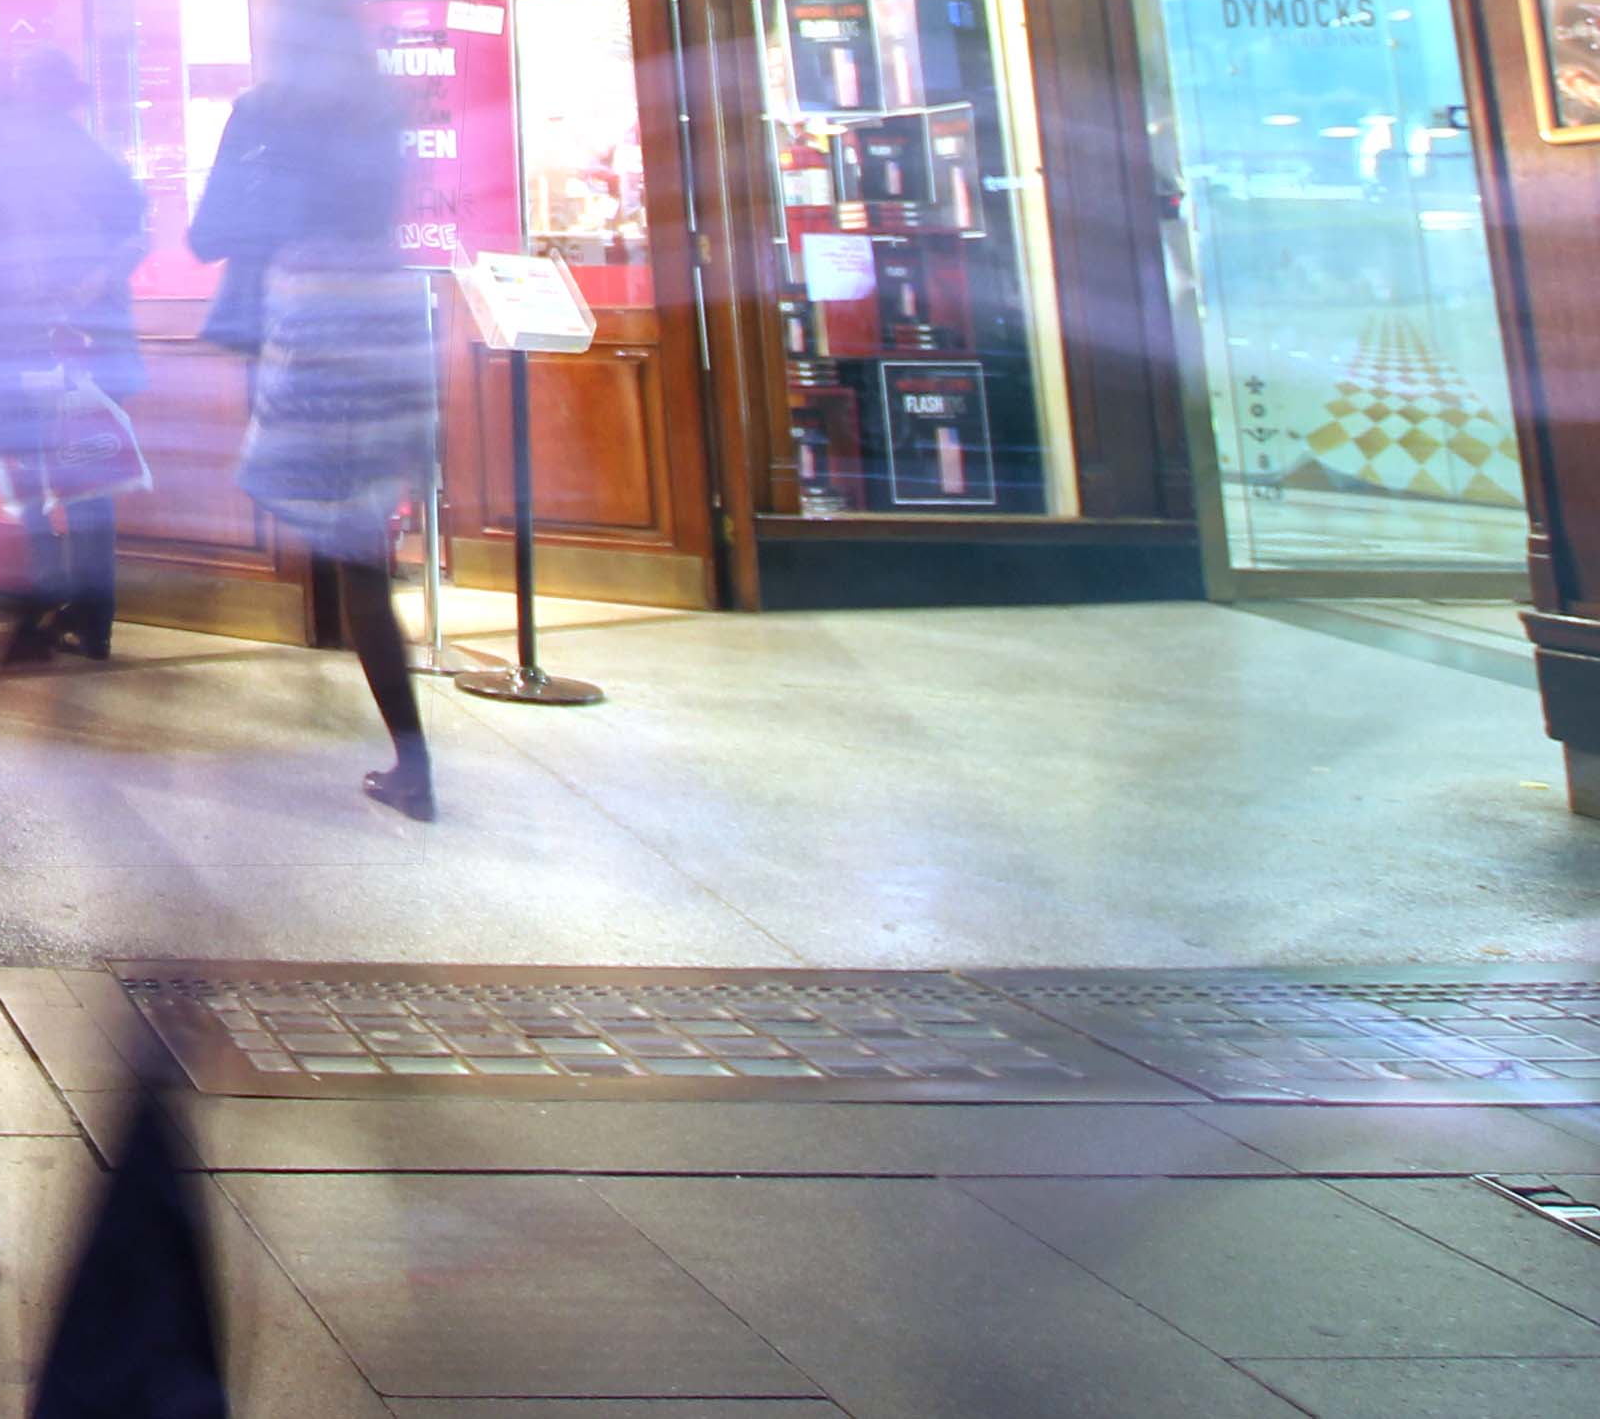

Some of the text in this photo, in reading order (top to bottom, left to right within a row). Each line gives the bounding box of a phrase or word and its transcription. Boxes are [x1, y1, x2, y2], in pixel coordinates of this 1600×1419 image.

[376, 48, 456, 76] MUM
[400, 130, 457, 158] PEN
[400, 223, 458, 250] NCE
